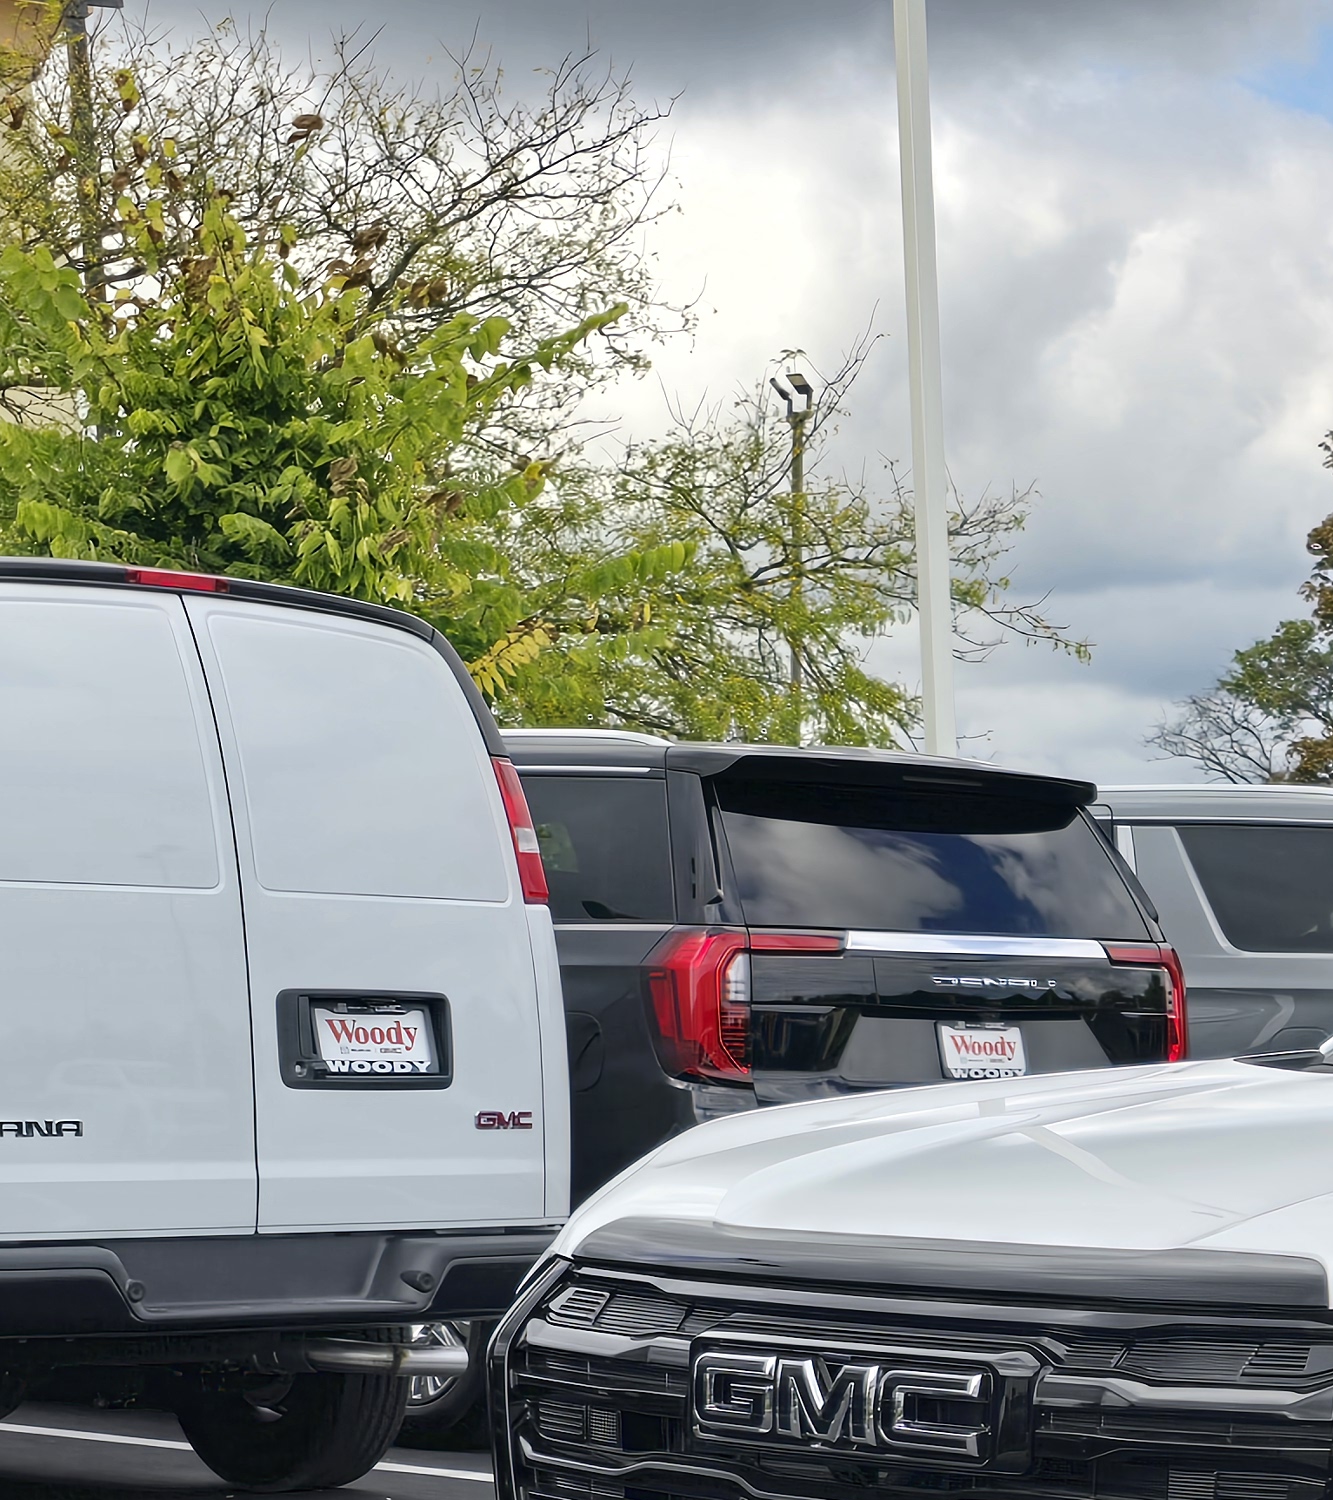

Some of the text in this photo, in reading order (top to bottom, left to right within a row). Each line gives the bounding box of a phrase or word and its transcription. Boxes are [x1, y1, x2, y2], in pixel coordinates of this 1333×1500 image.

[325, 1018, 418, 1051] Woody
[950, 1034, 1017, 1061] Woody
[326, 1060, 431, 1073] WOODY
[951, 1068, 1025, 1079] WOODY
[474, 1110, 533, 1130] GMC
[692, 1352, 994, 1458] GMC
